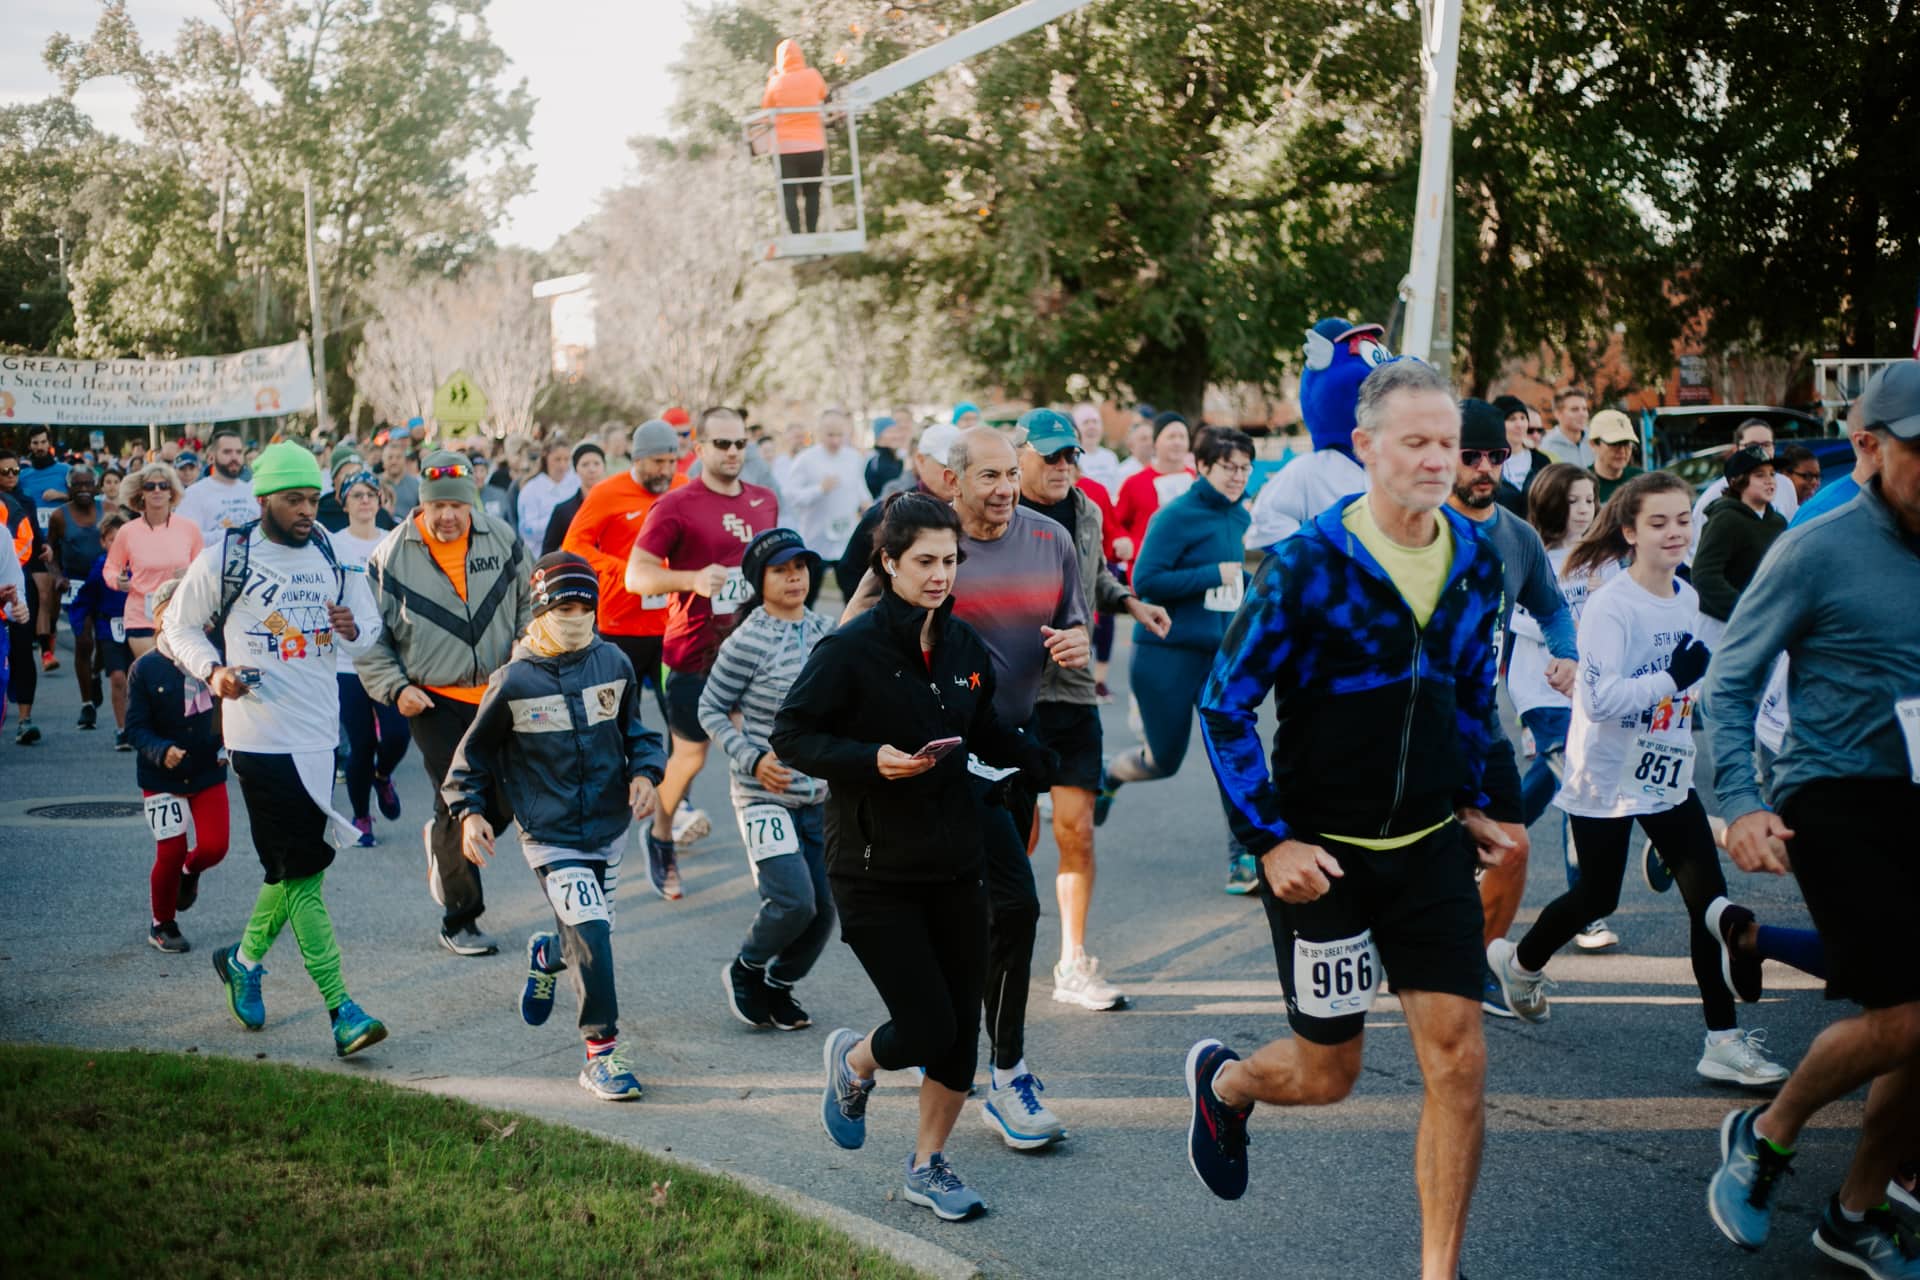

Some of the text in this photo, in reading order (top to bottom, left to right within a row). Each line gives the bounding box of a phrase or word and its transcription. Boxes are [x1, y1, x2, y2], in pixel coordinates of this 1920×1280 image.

[2, 357, 82, 373] GREAT
[94, 362, 200, 376] PUMPKIN
[14, 373, 72, 389] Sacred
[82, 375, 131, 391] Heart
[32, 391, 211, 411] Saturday, November
[722, 513, 753, 543] FSU
[469, 555, 500, 575] ARMY
[291, 572, 327, 585] ANNUAL
[281, 588, 321, 602] PUMPKIN
[1634, 751, 1683, 789] 851
[148, 801, 183, 830] 779
[560, 880, 603, 911] 781
[1324, 947, 1343, 958] GREAT
[1312, 951, 1372, 999] 966
